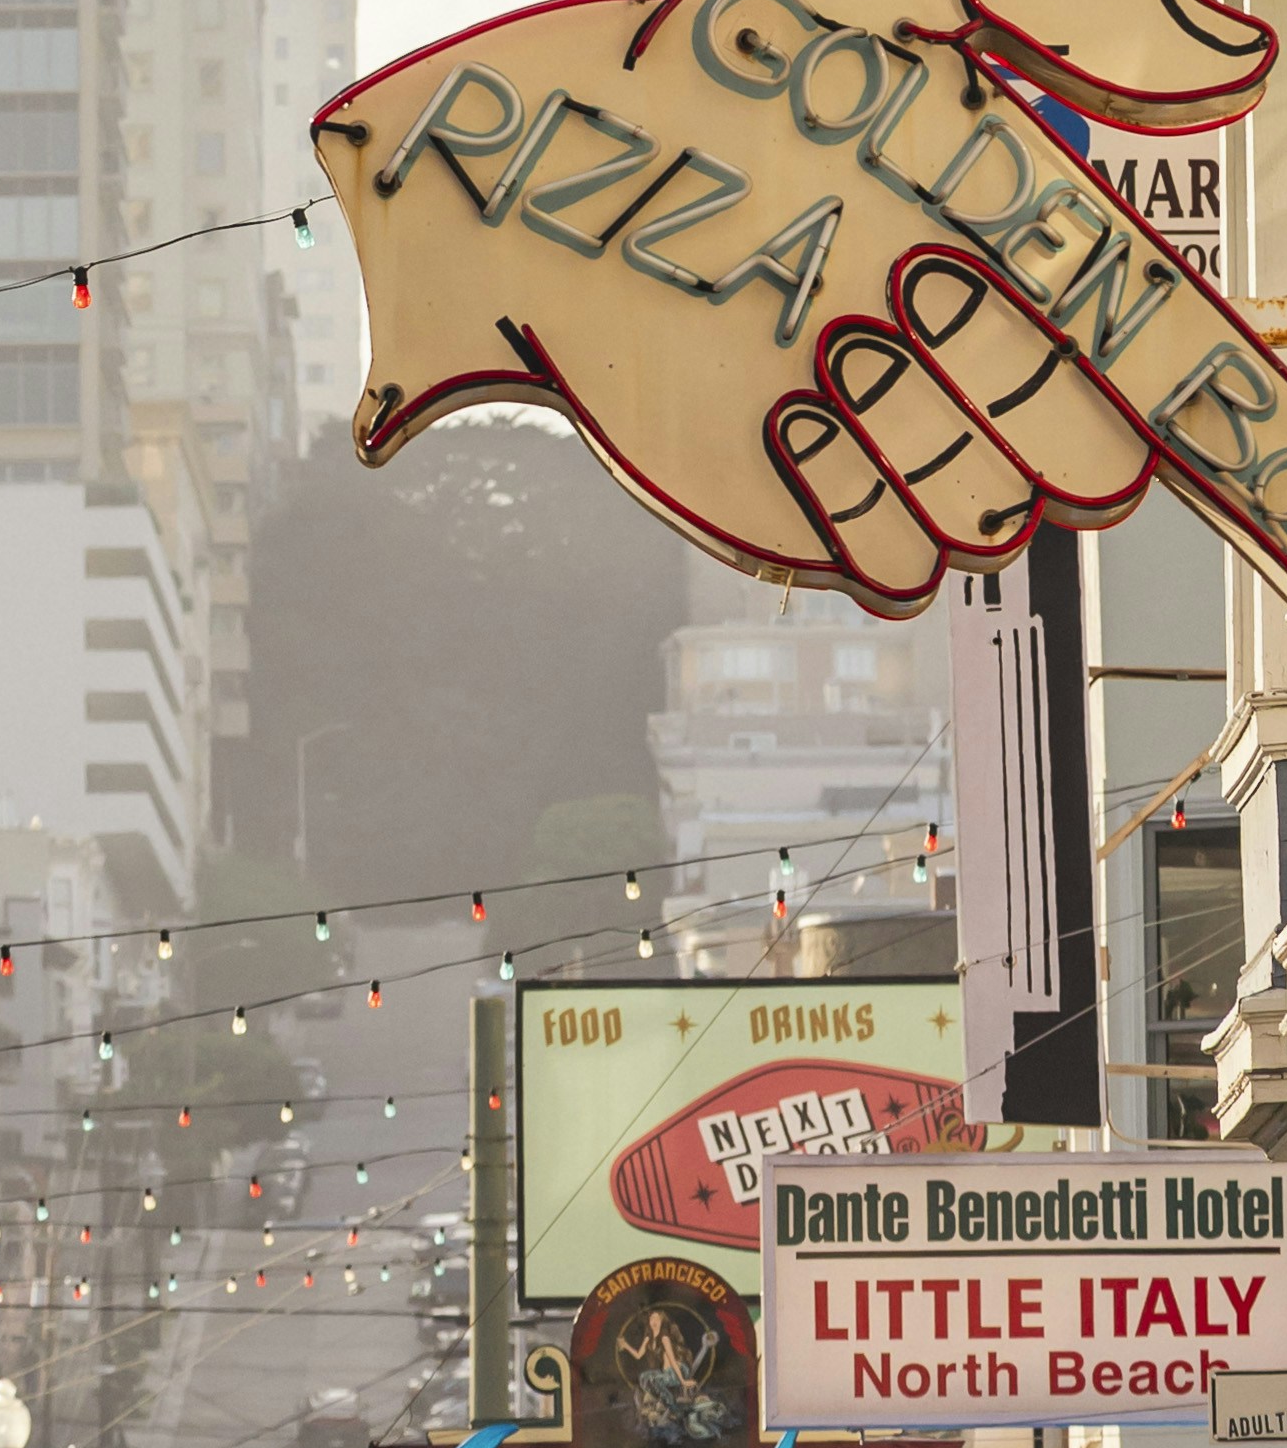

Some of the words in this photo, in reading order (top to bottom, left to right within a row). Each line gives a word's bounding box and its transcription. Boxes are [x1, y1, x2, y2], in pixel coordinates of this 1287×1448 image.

[373, 59, 846, 349] PIZZA
[543, 1007, 623, 1047] FOOD
[749, 1002, 876, 1045] DRINKS
[709, 1097, 853, 1153] NEXT
[776, 1183, 910, 1246] Dante
[926, 1177, 1147, 1242] Benedetti
[1164, 1176, 1285, 1239] Hotel
[597, 1271, 632, 1304] SAN
[629, 1261, 728, 1303] FRANCISCO
[814, 1277, 1046, 1341] LITTLE
[1079, 1274, 1267, 1339] ITALY
[853, 1351, 1019, 1399] North
[1049, 1349, 1231, 1397] Beach
[1228, 1411, 1286, 1438] ADULT
